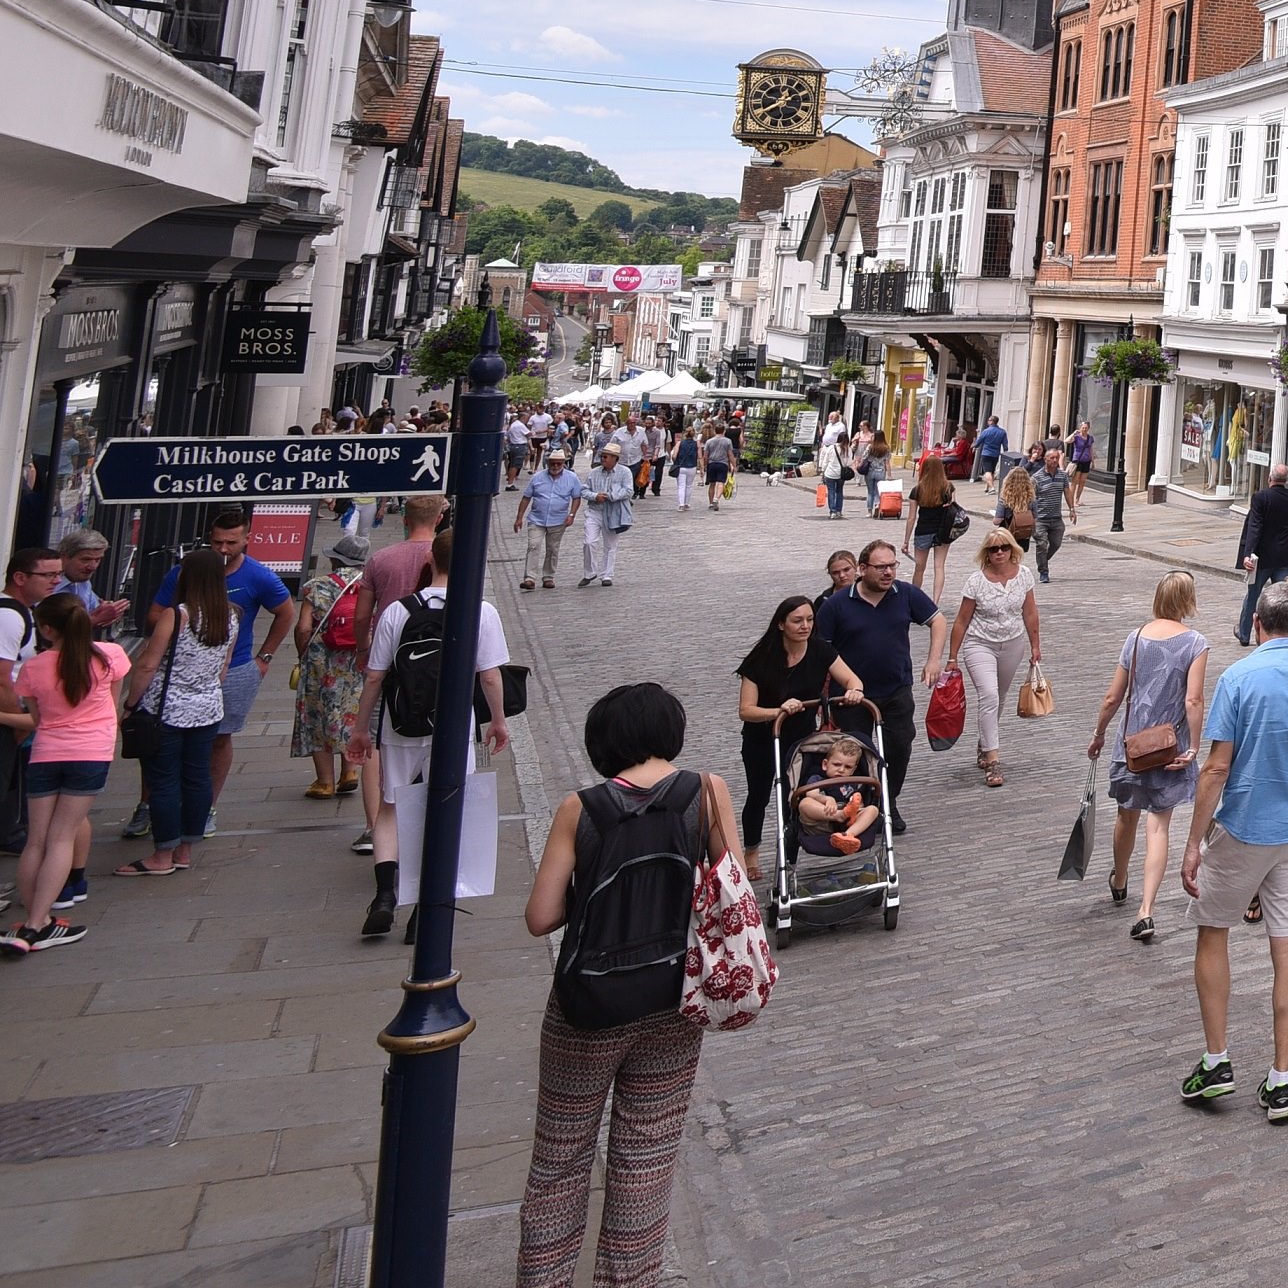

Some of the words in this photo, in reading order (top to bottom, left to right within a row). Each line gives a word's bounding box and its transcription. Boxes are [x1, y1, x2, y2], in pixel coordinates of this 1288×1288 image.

[615, 270, 640, 283] fringe
[660, 278, 677, 286] July
[67, 312, 97, 348] MOSS
[240, 328, 294, 340] MOSS
[239, 343, 297, 355] BROS.
[1184, 430, 1199, 444] SALE
[156, 445, 277, 466] Milkhouse
[283, 444, 332, 463] Gate
[338, 442, 401, 462] Shops
[153, 473, 225, 493] Castle
[230, 472, 248, 491] &
[253, 472, 295, 491] Car
[300, 470, 350, 490] Park
[253, 532, 301, 544] SALE
